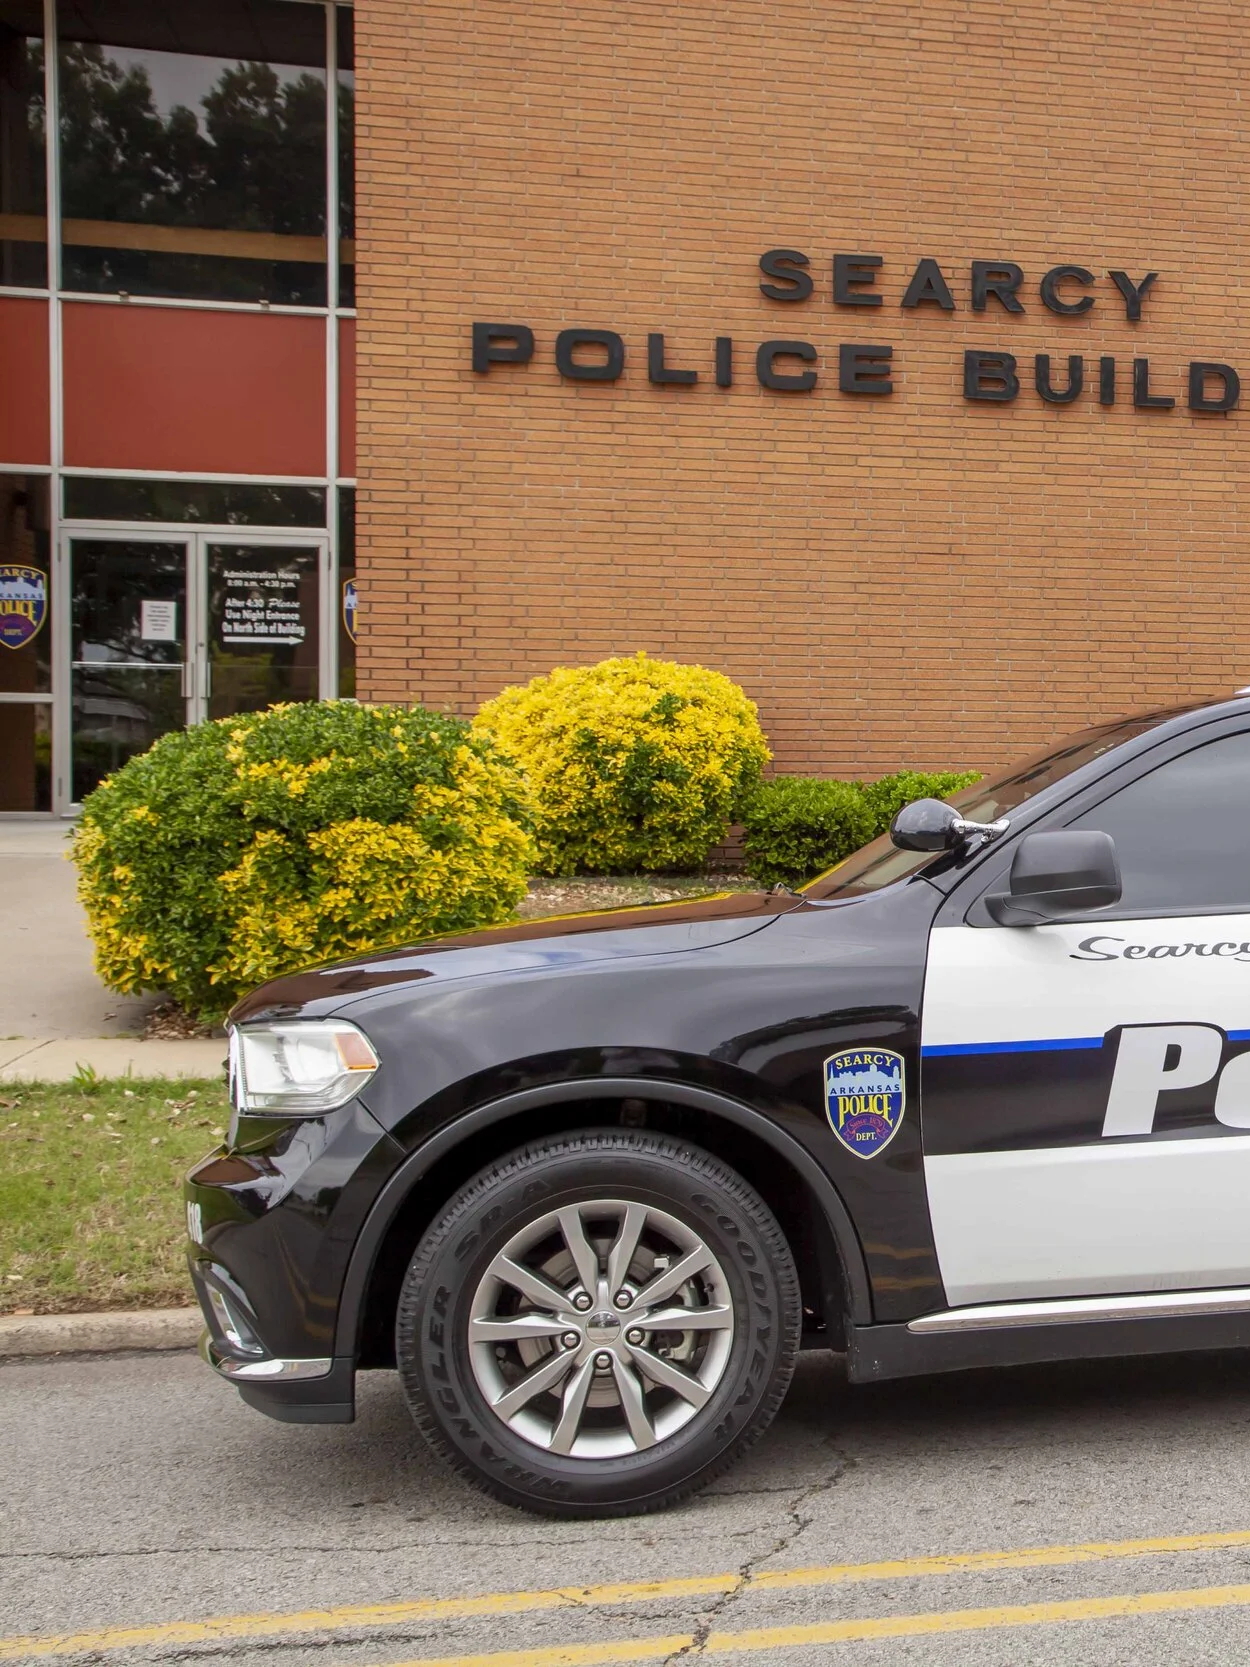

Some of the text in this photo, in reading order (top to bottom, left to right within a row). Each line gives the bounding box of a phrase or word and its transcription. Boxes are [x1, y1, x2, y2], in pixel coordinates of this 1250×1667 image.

[758, 248, 1160, 321] SEARCY
[472, 321, 893, 395] POLICE
[277, 571, 300, 580] Hours
[224, 597, 301, 609] After 4:30 Please
[224, 608, 301, 622] Use Night Entrance
[221, 621, 306, 637] On North Side of Building
[835, 1054, 895, 1070] SEARCY
[829, 1084, 900, 1095] ARKANSAS
[837, 1094, 894, 1131] POLICE
[855, 1132, 878, 1142] DEPT.
[690, 1193, 773, 1442] GOODYEAR
[428, 1284, 570, 1490] WRANGLER
